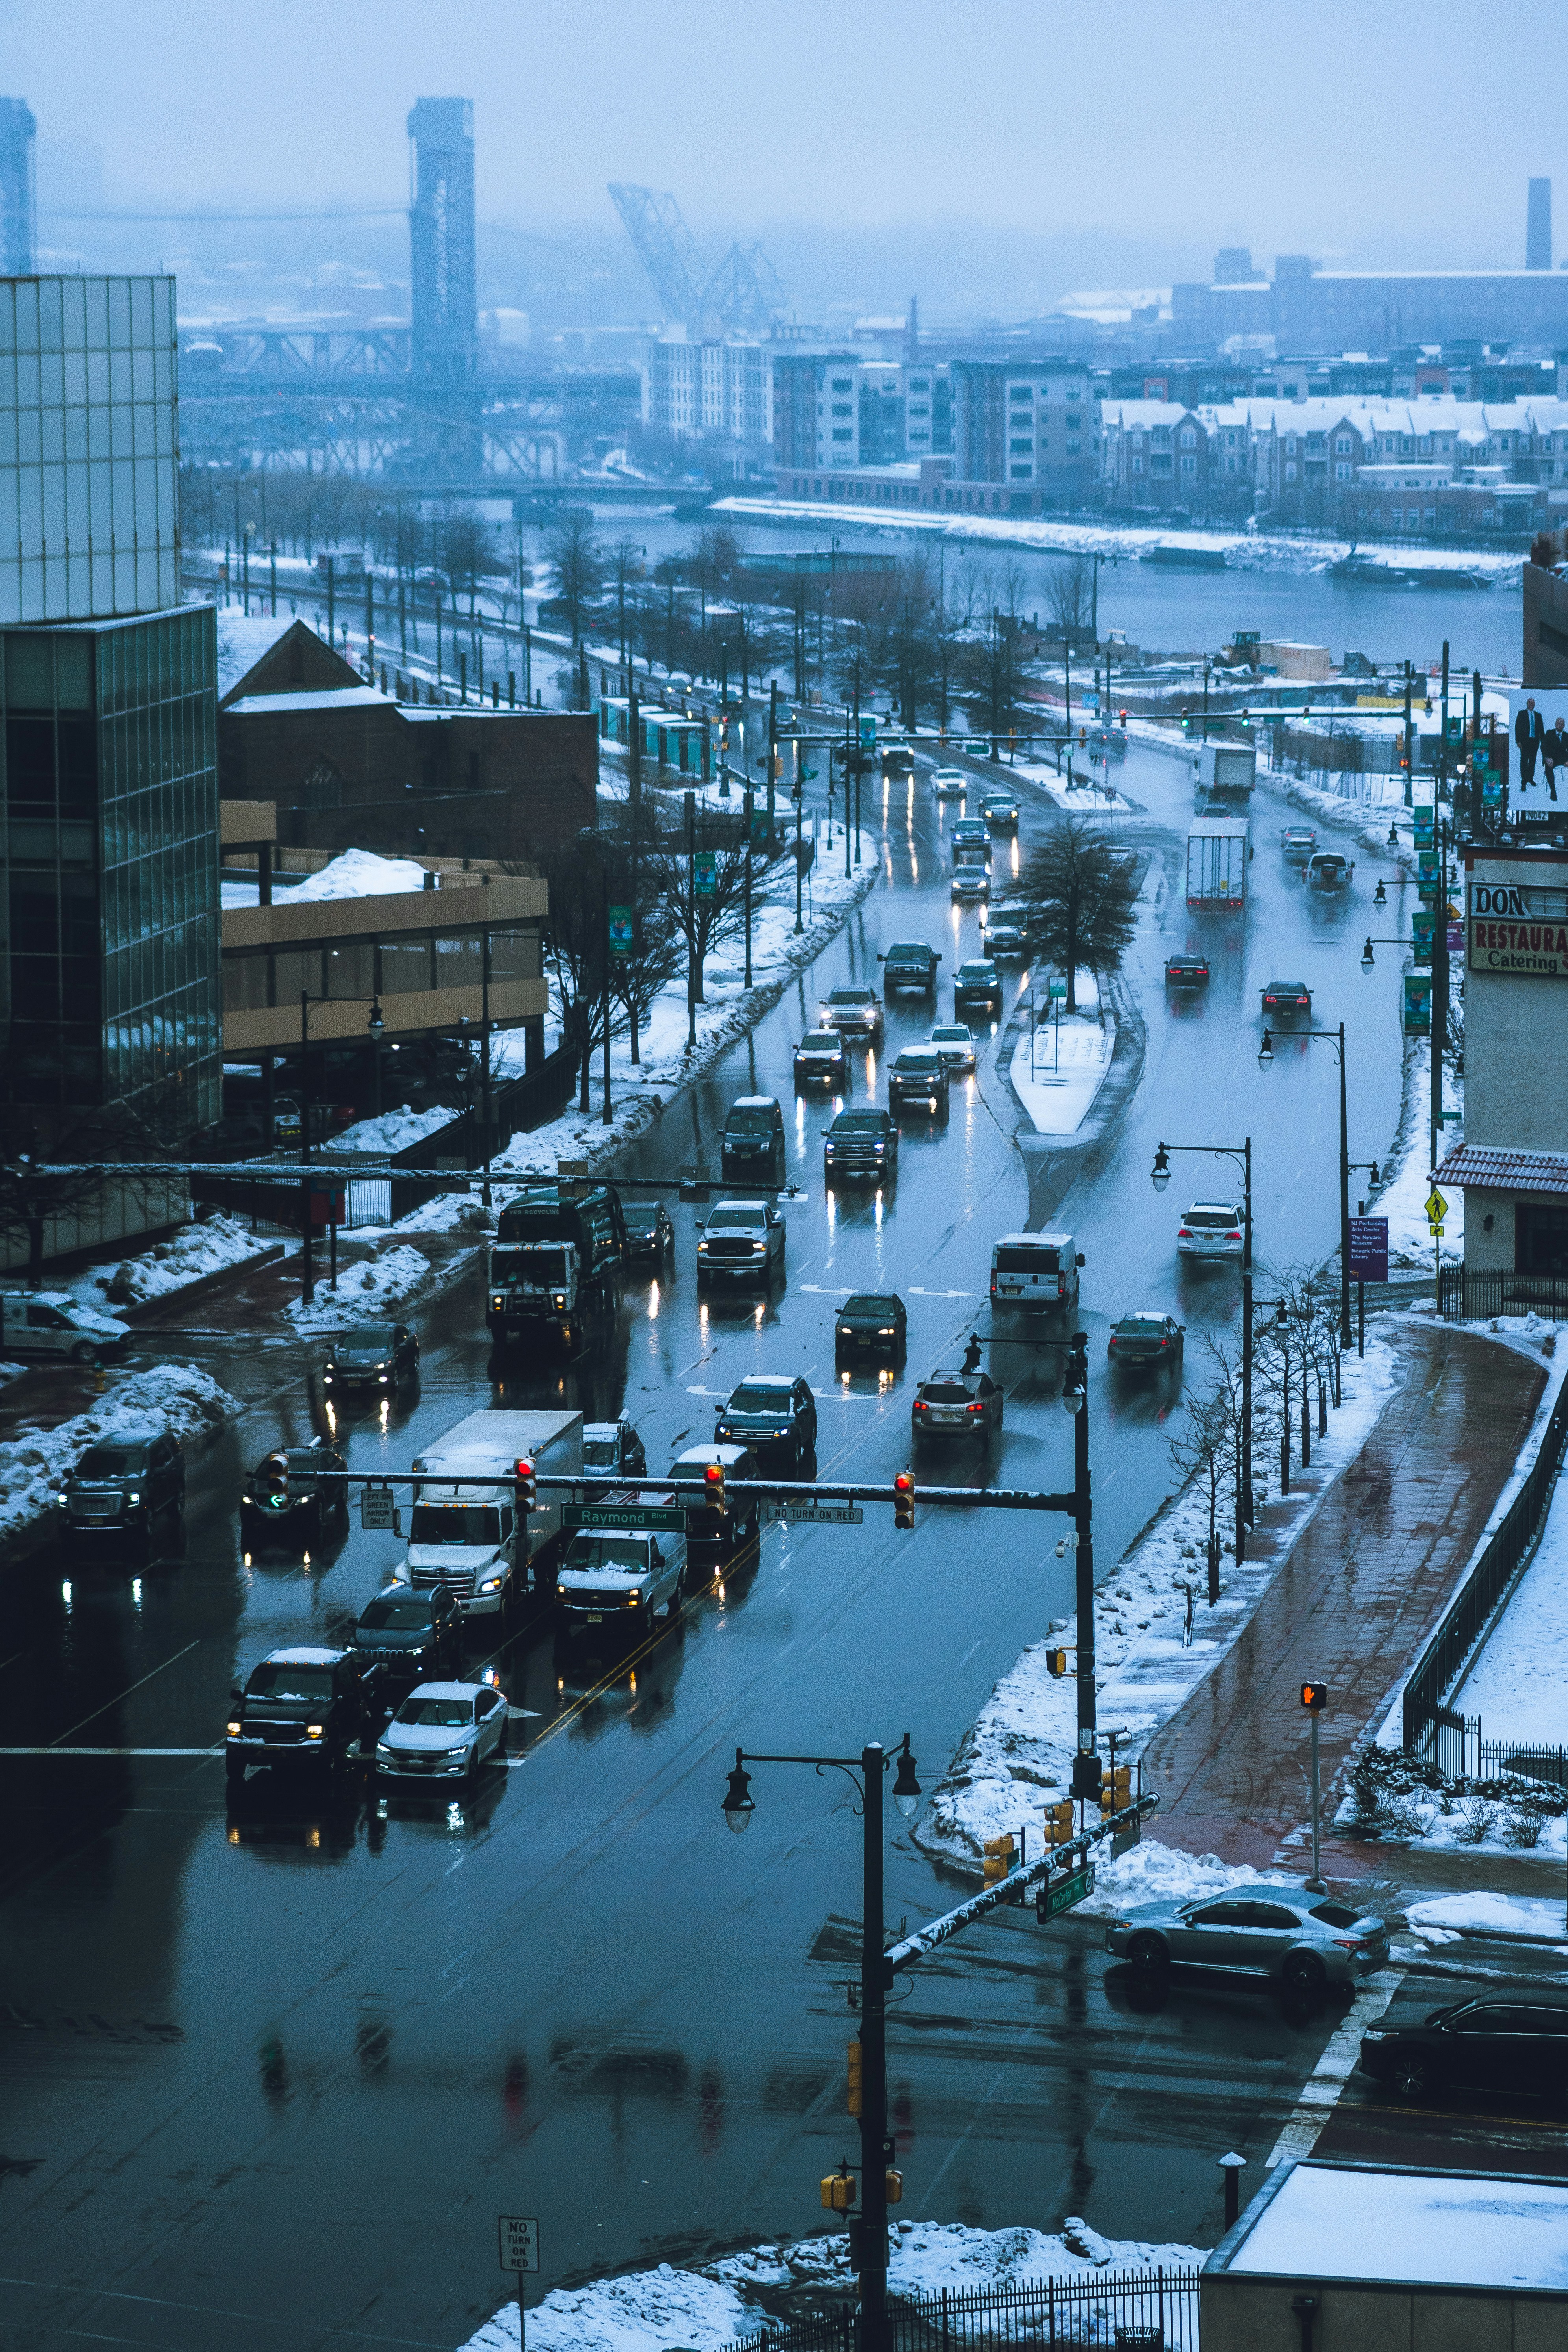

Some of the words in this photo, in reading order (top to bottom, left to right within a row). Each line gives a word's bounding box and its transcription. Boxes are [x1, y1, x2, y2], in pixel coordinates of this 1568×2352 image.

[1475, 887, 1525, 916] DON
[1488, 950, 1557, 973] Catering
[582, 1510, 645, 1525] Raymond
[775, 1509, 787, 1518] NO
[791, 1509, 814, 1519] TURN
[819, 1510, 832, 1519] ON
[837, 1511, 855, 1520] RED
[1052, 1889, 1072, 1911] McCarter
[509, 2222, 528, 2233] NO
[508, 2235, 531, 2244] TURN
[512, 2247, 526, 2256] ON
[511, 2258, 528, 2268] RED
